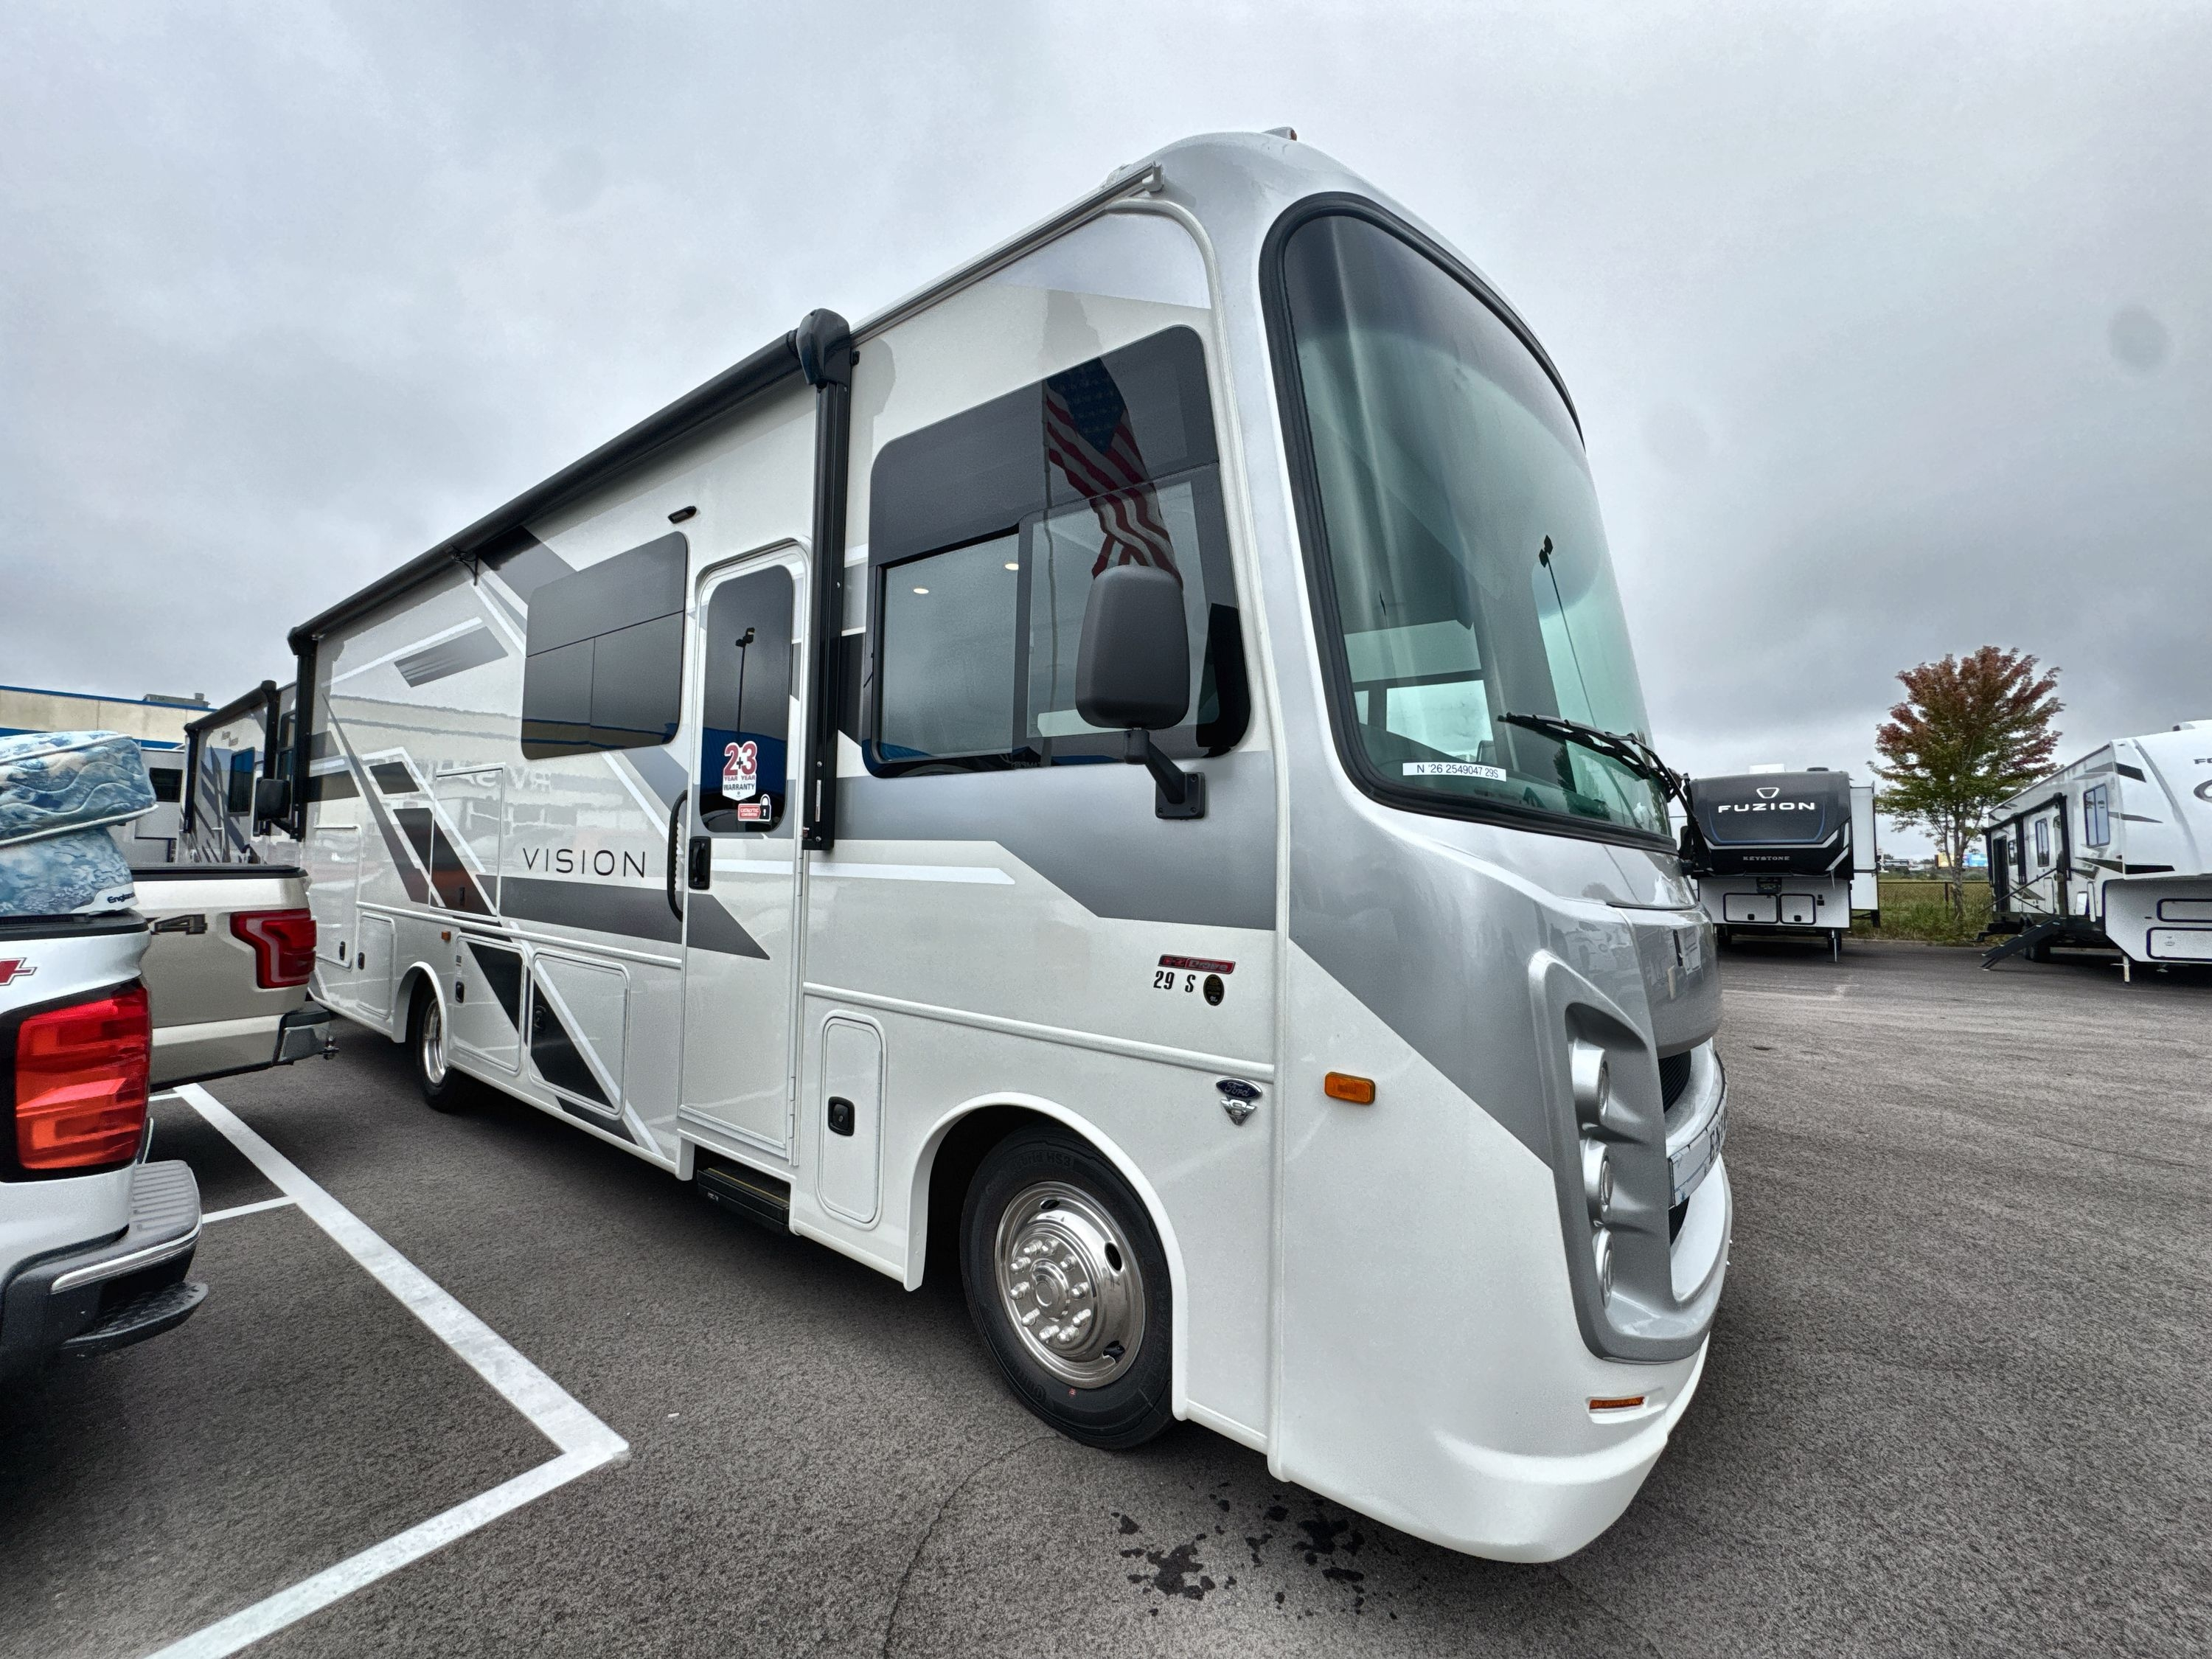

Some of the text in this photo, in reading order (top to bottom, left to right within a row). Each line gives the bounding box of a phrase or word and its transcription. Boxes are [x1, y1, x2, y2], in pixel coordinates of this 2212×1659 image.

[1416, 765, 1425, 773] N
[1446, 764, 1483, 775] 2549047
[1485, 768, 1499, 779] 29S
[723, 783, 755, 791] WARRANTY
[1718, 802, 1815, 813] FUZION
[523, 848, 645, 878] VISION
[1153, 970, 1175, 990] 29
[1184, 974, 1196, 993] S
[1225, 1081, 1251, 1097] Ford
